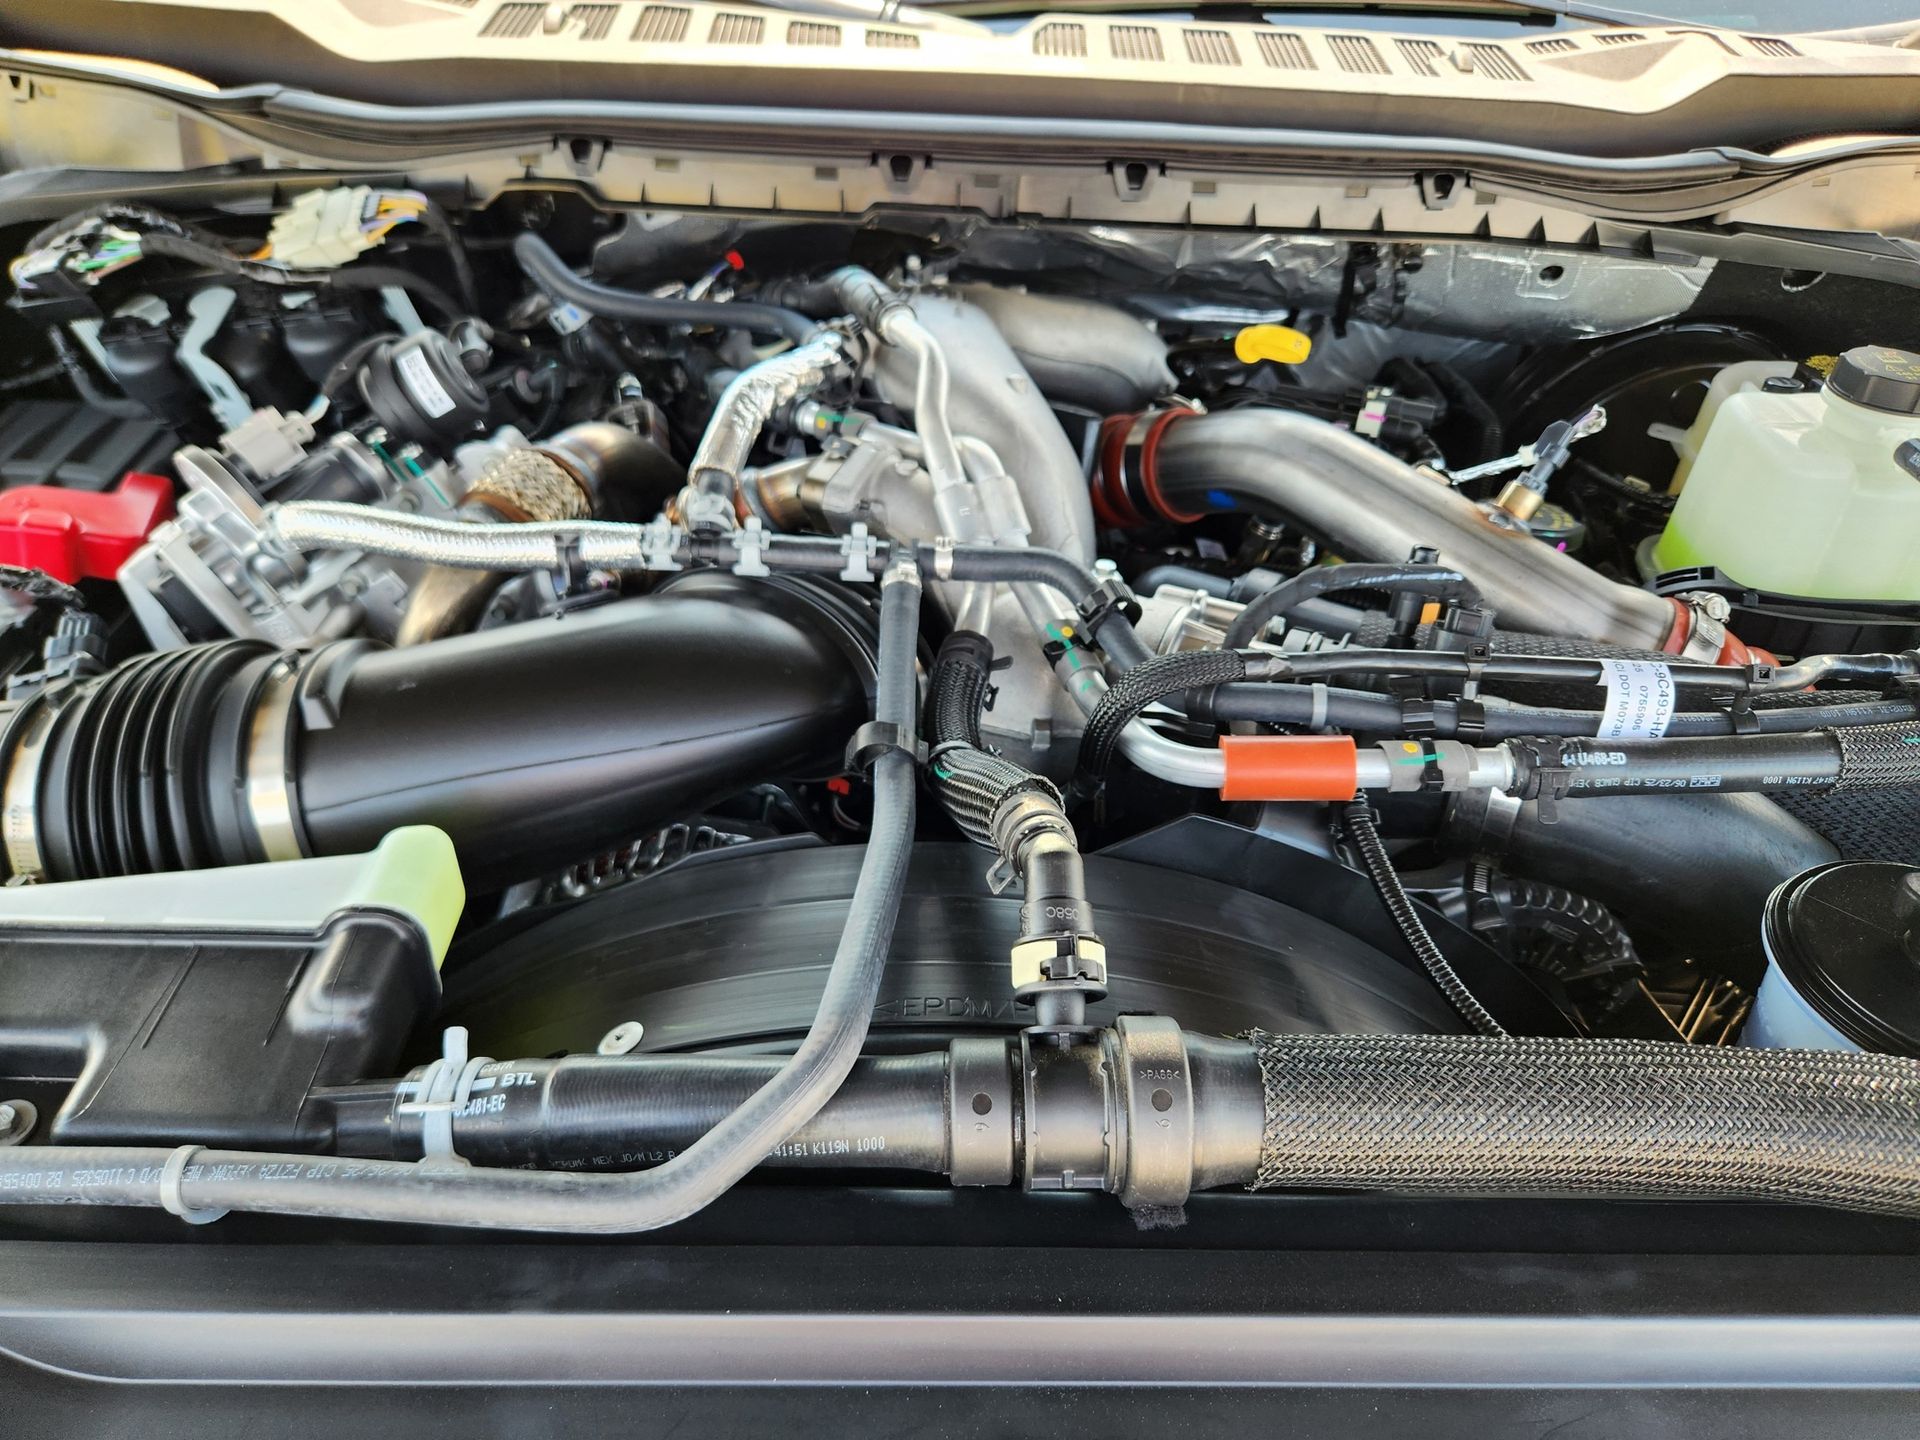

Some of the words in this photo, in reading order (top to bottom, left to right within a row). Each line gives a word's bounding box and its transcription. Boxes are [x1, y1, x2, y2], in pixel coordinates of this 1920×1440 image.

[1619, 674, 1630, 698] DOT
[1611, 701, 1629, 737] M073B
[1762, 775, 1782, 785] 1000
[1786, 775, 1812, 785] K119N
[500, 1071, 537, 1088] BTL
[812, 1139, 850, 1155] K119N
[857, 1135, 886, 1152] 1000
[592, 1156, 614, 1166] MEX
